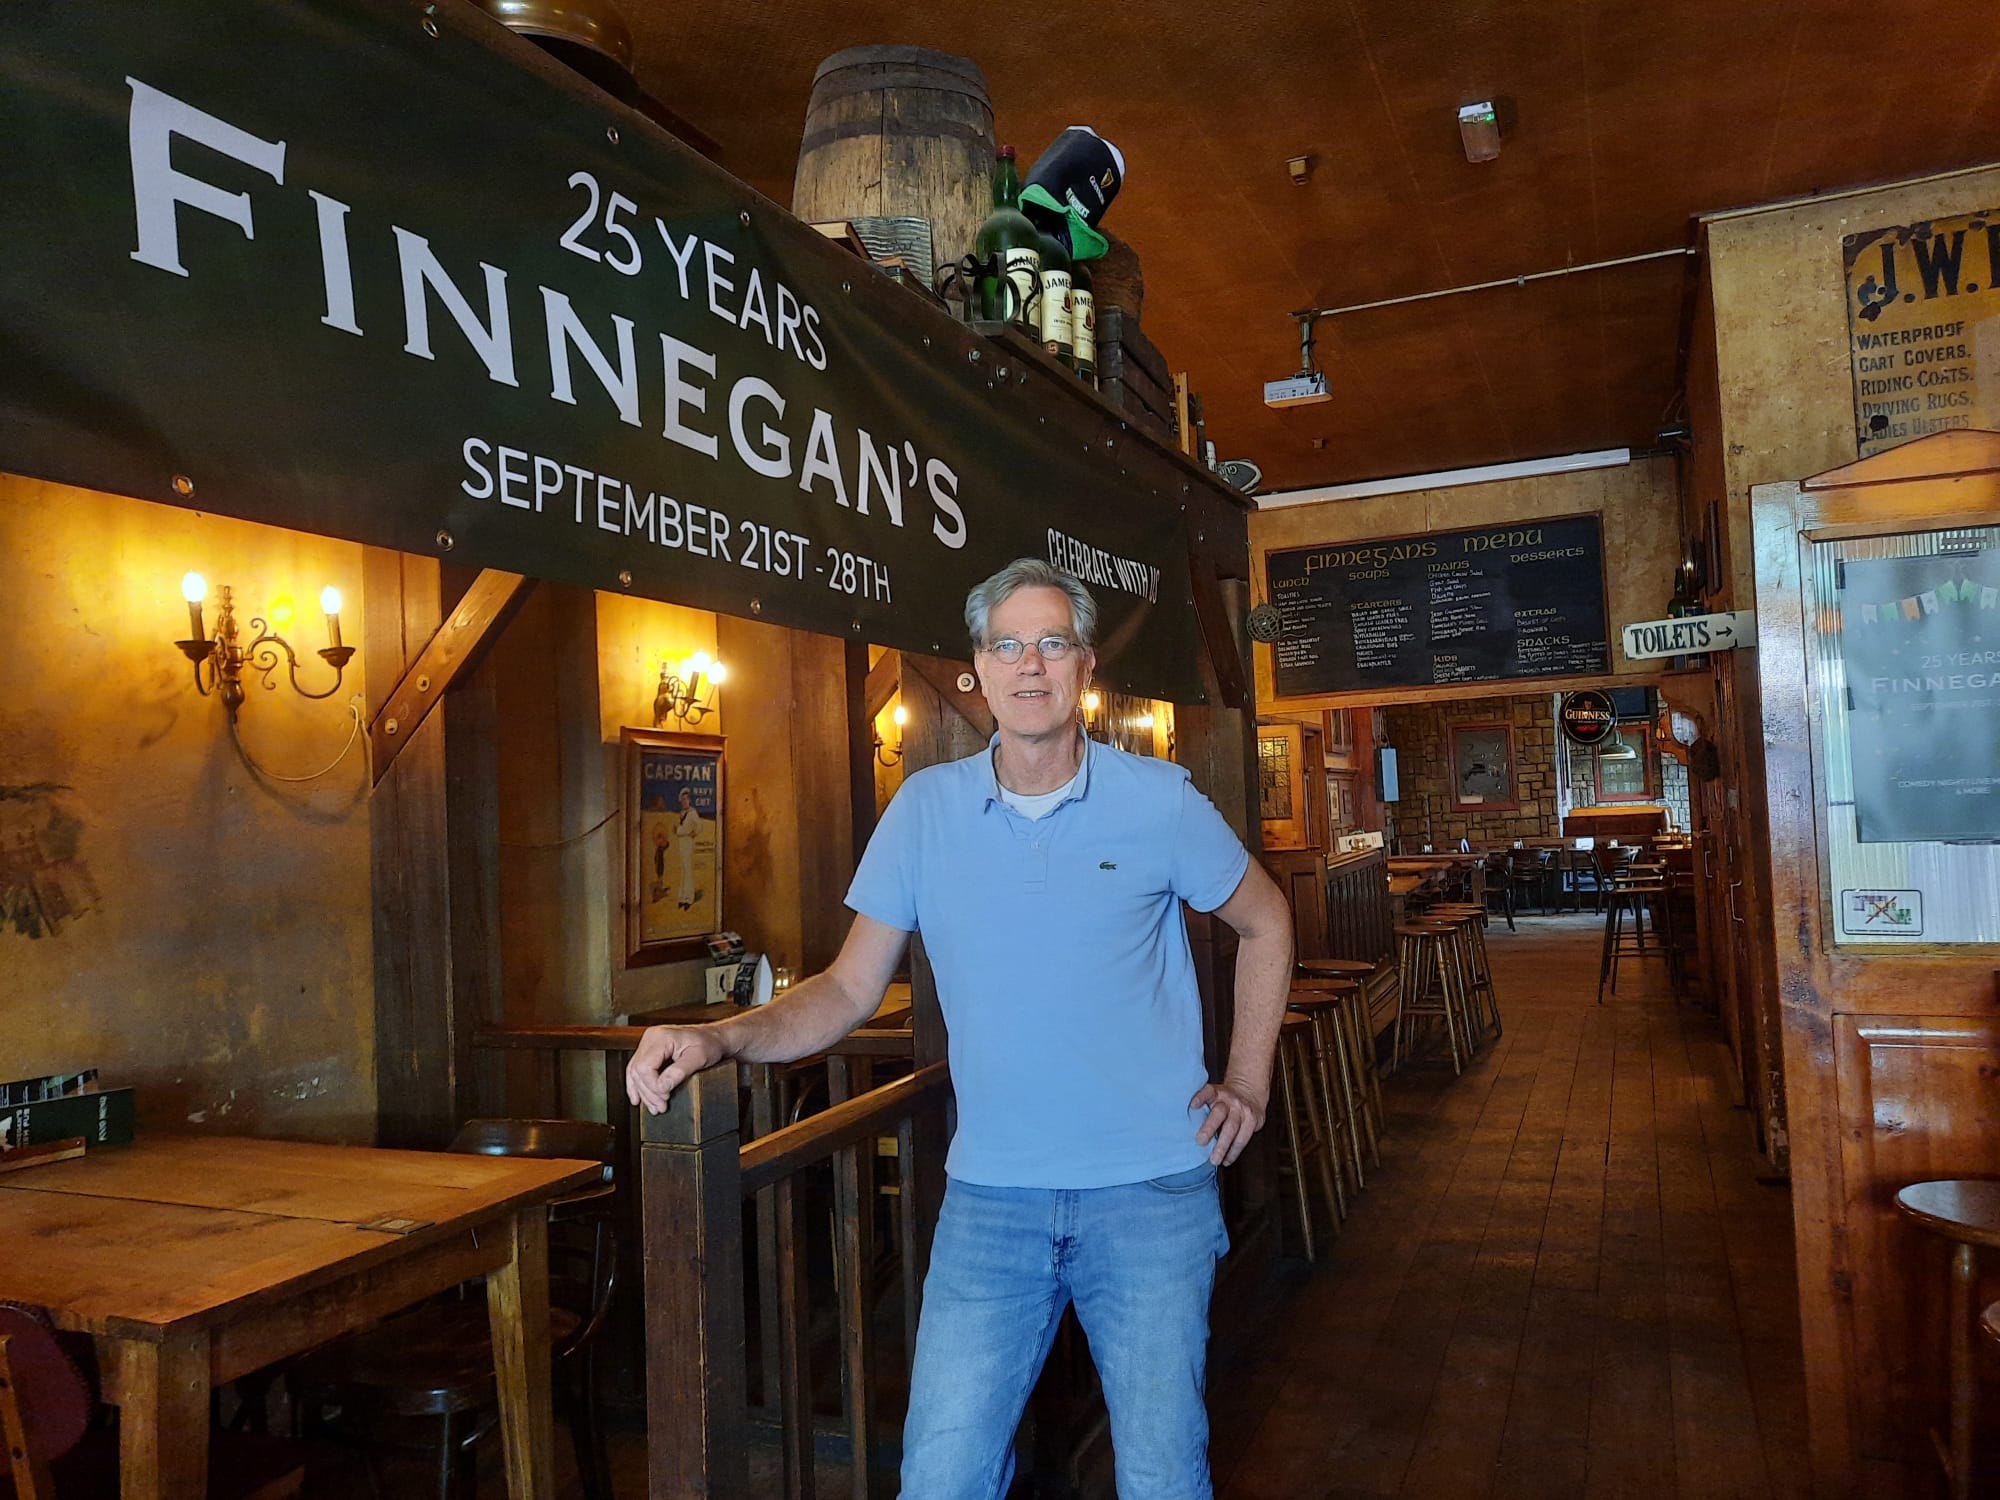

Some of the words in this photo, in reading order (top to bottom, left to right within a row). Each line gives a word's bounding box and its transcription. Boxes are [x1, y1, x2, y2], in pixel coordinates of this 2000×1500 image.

[560, 171, 642, 277] 25
[656, 217, 827, 371] YEARS
[126, 75, 967, 549] FINNEGAN'S
[1857, 321, 1965, 350] WATERPROOF
[1859, 355, 1895, 373] CART
[1904, 344, 1971, 366] COVERS.
[1860, 375, 1913, 396] RIDING
[1917, 367, 1974, 387] COATS.
[1862, 397, 1920, 419] DRIVING
[1927, 391, 1974, 409] RUGS.
[461, 437, 731, 562] SEPTEMBER
[740, 520, 810, 580] 21ST
[826, 548, 892, 603] 28TH
[1048, 528, 1119, 590] CELEBRATE
[1112, 555, 1148, 599] WITH
[1630, 621, 1711, 654] TOILETS
[1921, 655, 1941, 668] 25
[1565, 709, 1610, 720] GUINNESS
[644, 763, 711, 781] CAPSTAN
